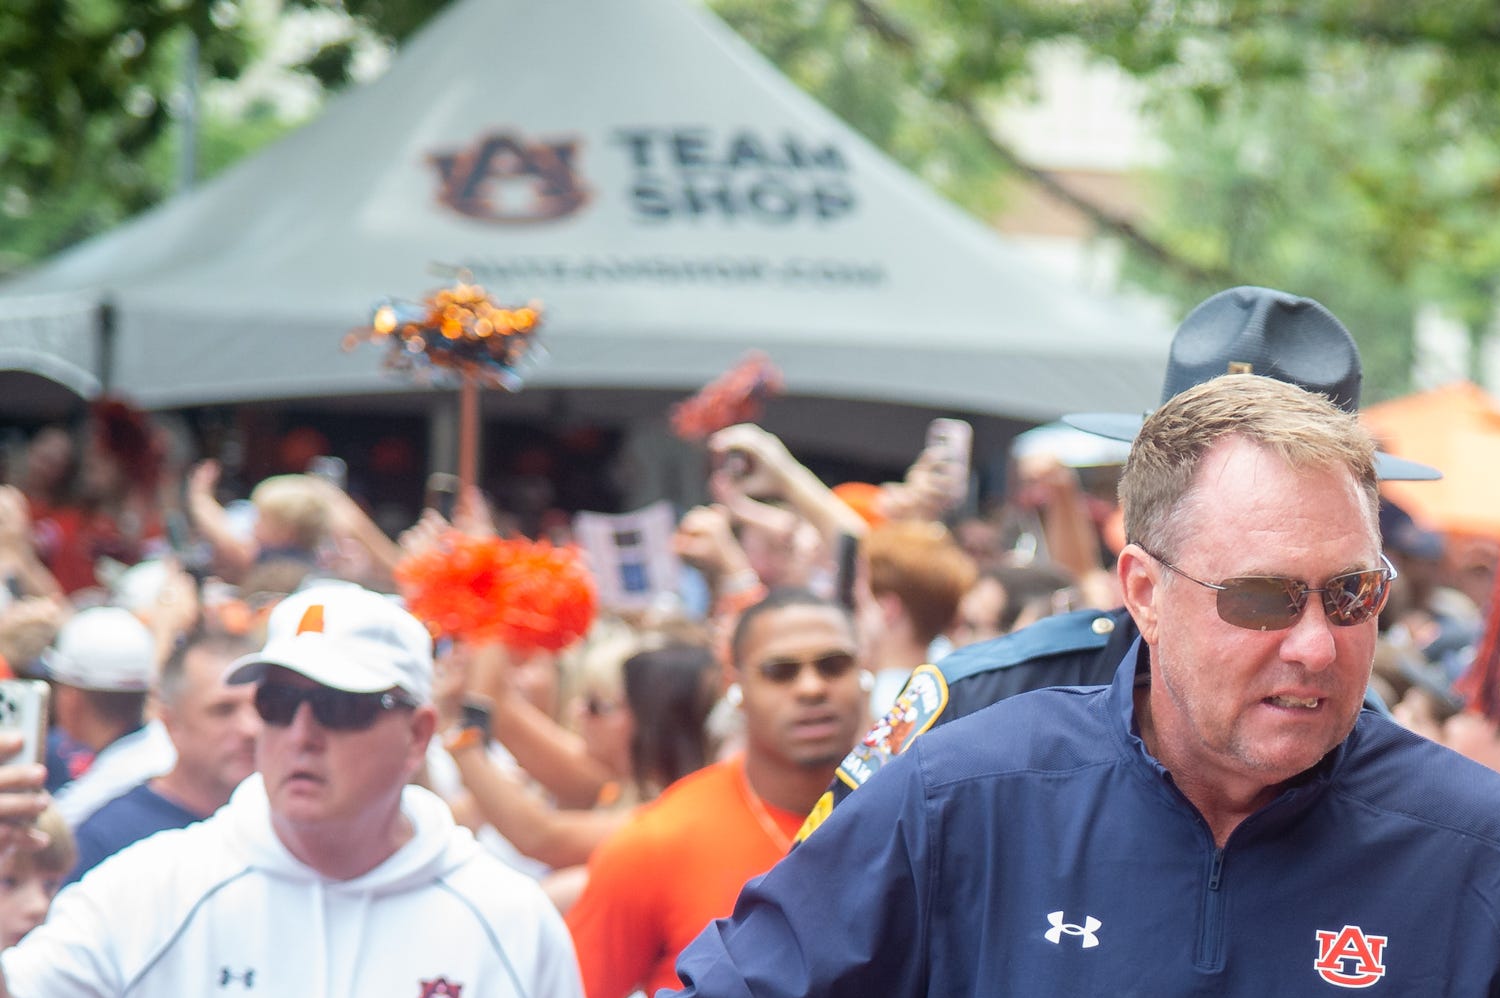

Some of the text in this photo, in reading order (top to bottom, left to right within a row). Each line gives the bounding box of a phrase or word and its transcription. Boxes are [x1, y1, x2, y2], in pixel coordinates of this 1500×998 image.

[613, 124, 851, 172] TEAM
[630, 176, 857, 225] SHOP
[1314, 925, 1388, 988] AU
